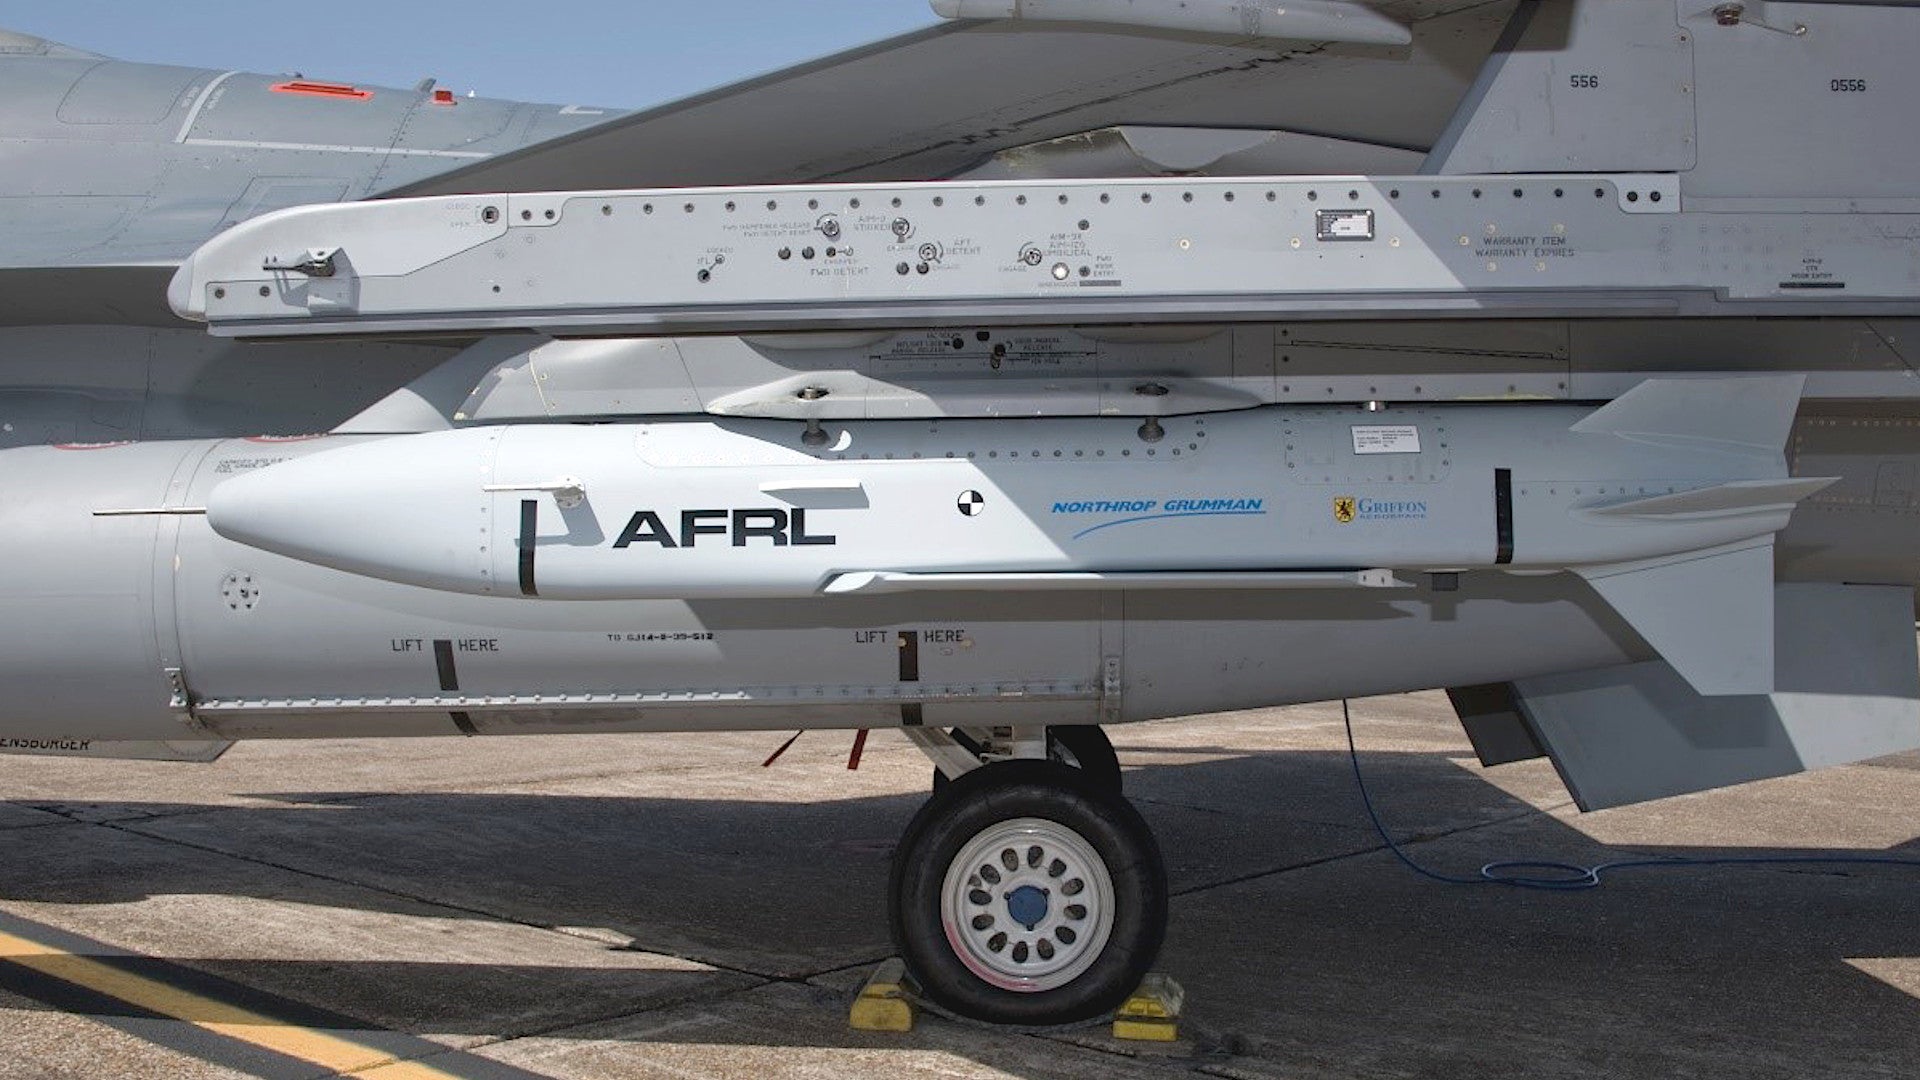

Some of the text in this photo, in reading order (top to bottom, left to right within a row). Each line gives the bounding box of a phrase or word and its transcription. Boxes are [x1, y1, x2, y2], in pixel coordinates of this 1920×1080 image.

[1569, 74, 1599, 89] 556
[1830, 78, 1867, 92] 0556
[1483, 236, 1567, 246] WARRANTY ITEM
[1475, 248, 1576, 258] WARRANTY EXPIRES
[1051, 499, 1263, 513] NORTHROP GRUMMAN
[1358, 498, 1427, 513] GRIFFON
[612, 508, 836, 548] AFRL
[855, 629, 965, 643] LIFT HERE
[391, 638, 499, 651] LIFT HERE
